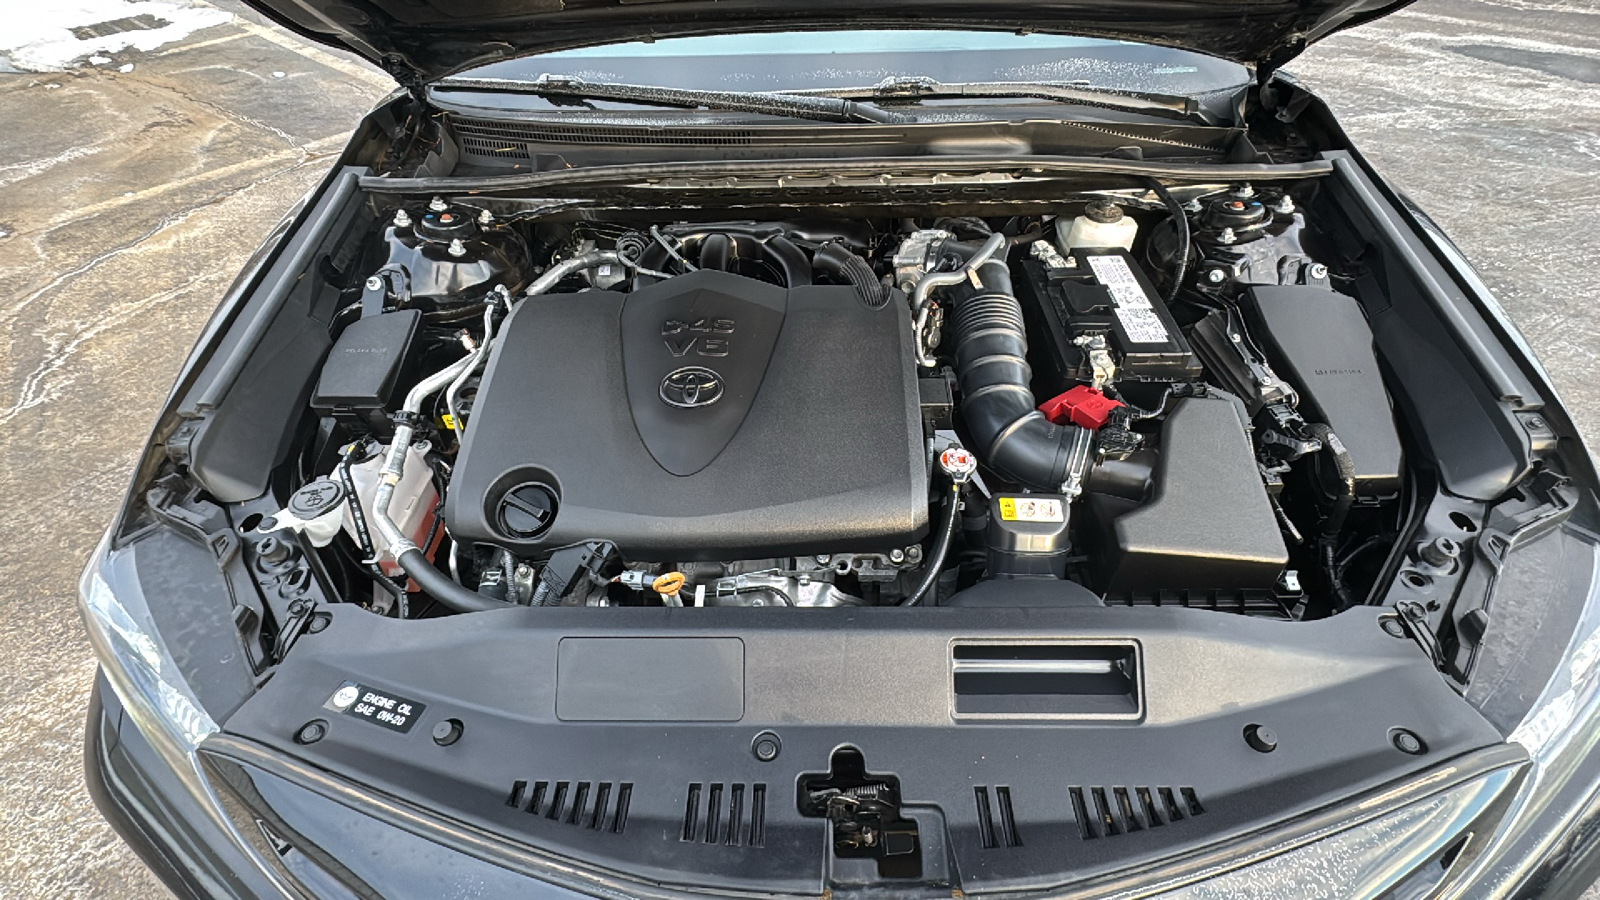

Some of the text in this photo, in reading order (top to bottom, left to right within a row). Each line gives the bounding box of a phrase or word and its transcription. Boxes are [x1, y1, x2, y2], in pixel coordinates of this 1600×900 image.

[664, 337, 729, 357] V6
[354, 703, 375, 716] SAE
[361, 692, 412, 716] ENGINE OIL
